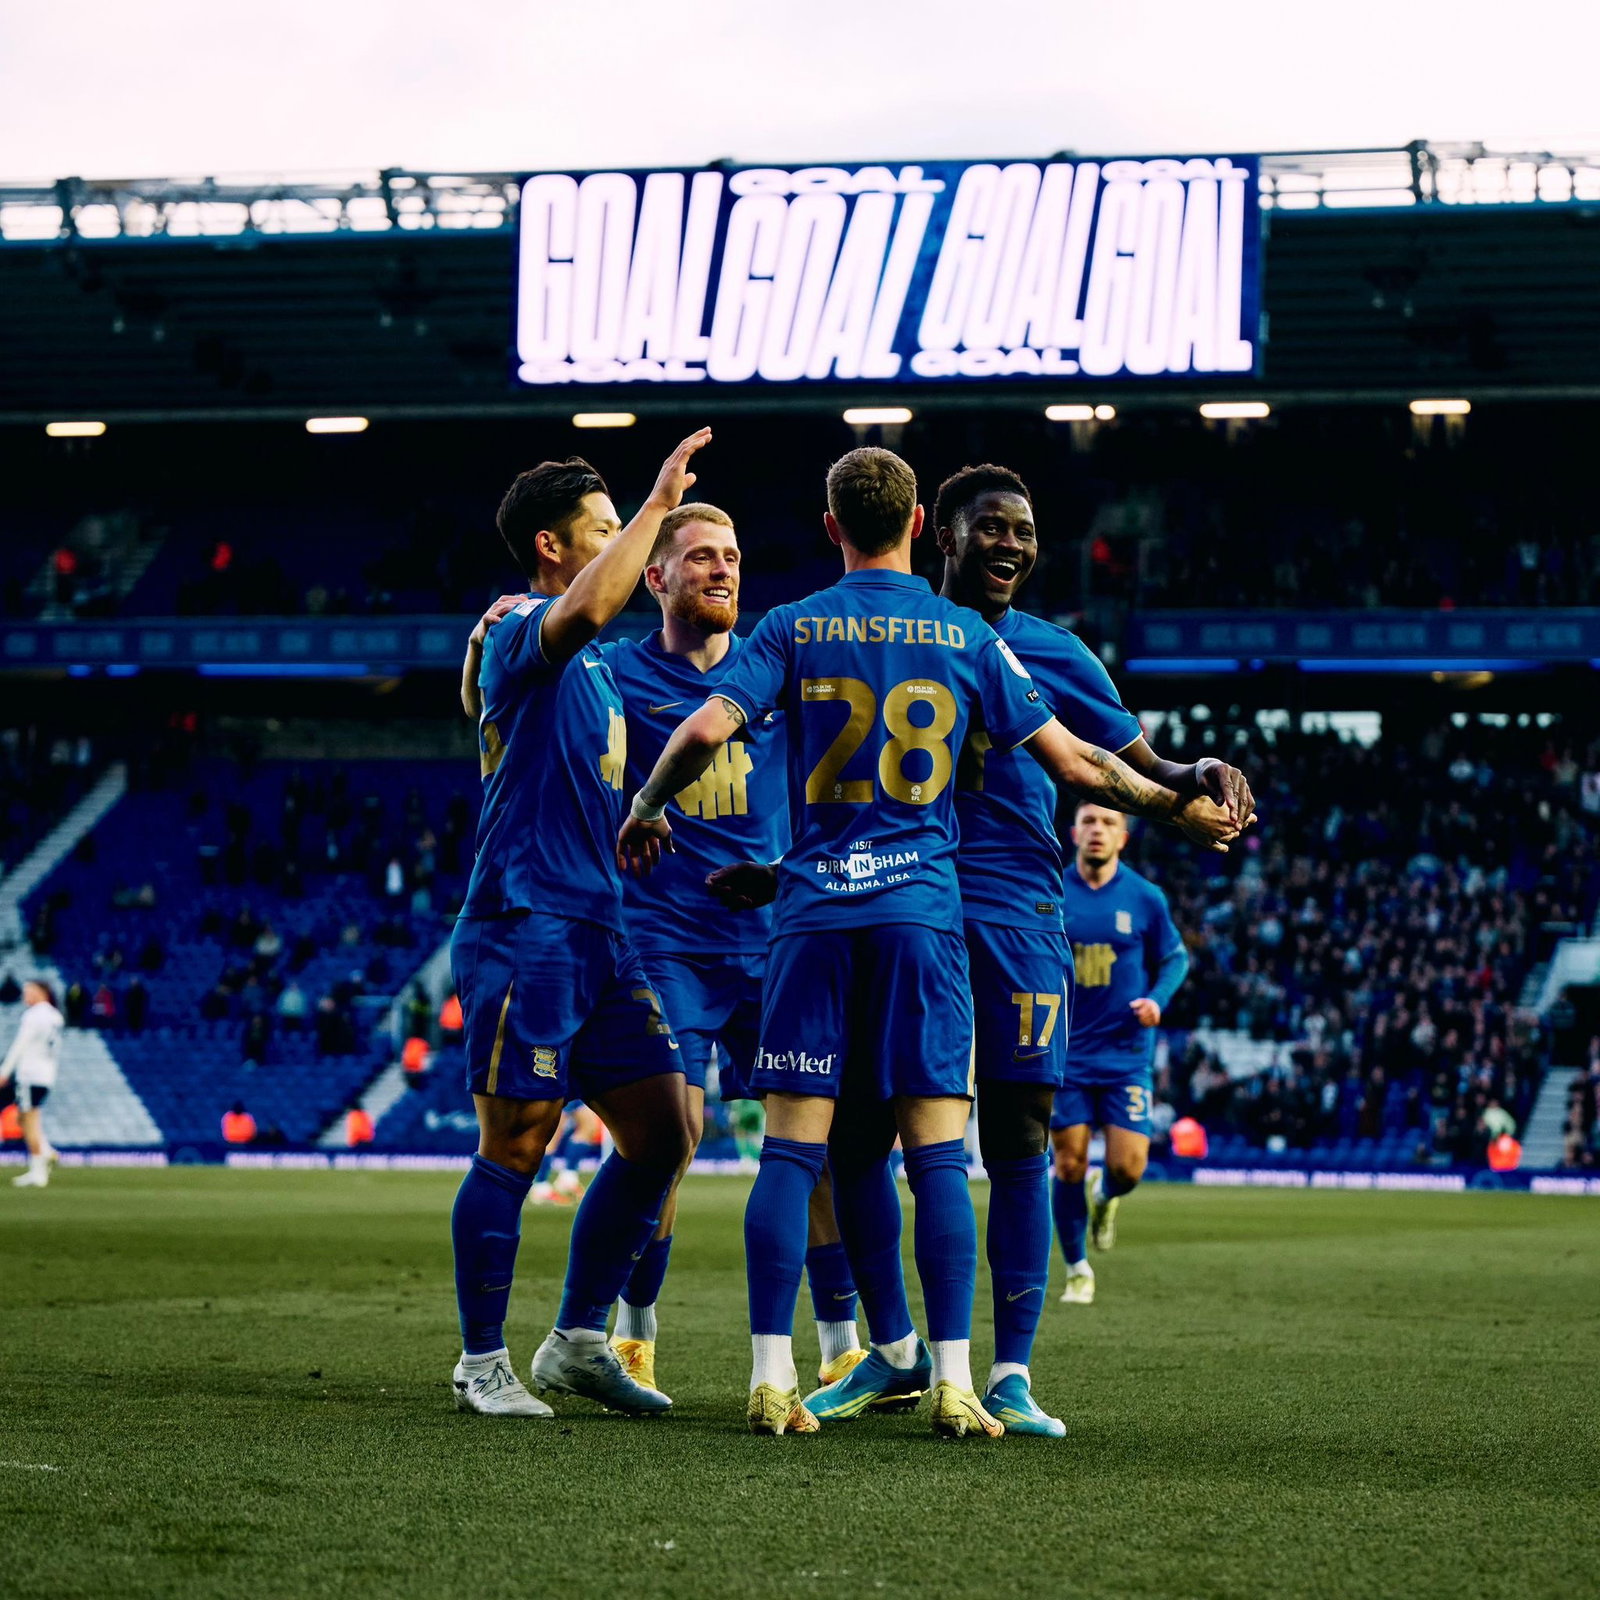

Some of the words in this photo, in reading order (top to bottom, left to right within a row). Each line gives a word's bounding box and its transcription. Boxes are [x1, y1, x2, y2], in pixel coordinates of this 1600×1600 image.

[517, 172, 711, 363] GOAL
[917, 162, 1100, 351] GOAL
[1079, 178, 1253, 376] GOAL
[709, 191, 936, 382] GOAL
[794, 616, 966, 649] STANSFIELD
[801, 677, 957, 805] 28
[817, 851, 919, 874] BIRMINGHAM
[849, 840, 873, 850] VISIT
[825, 879, 884, 892] ALABAMA,
[886, 872, 910, 884] USA
[1011, 992, 1061, 1047] 17
[753, 1046, 832, 1075] heMed
